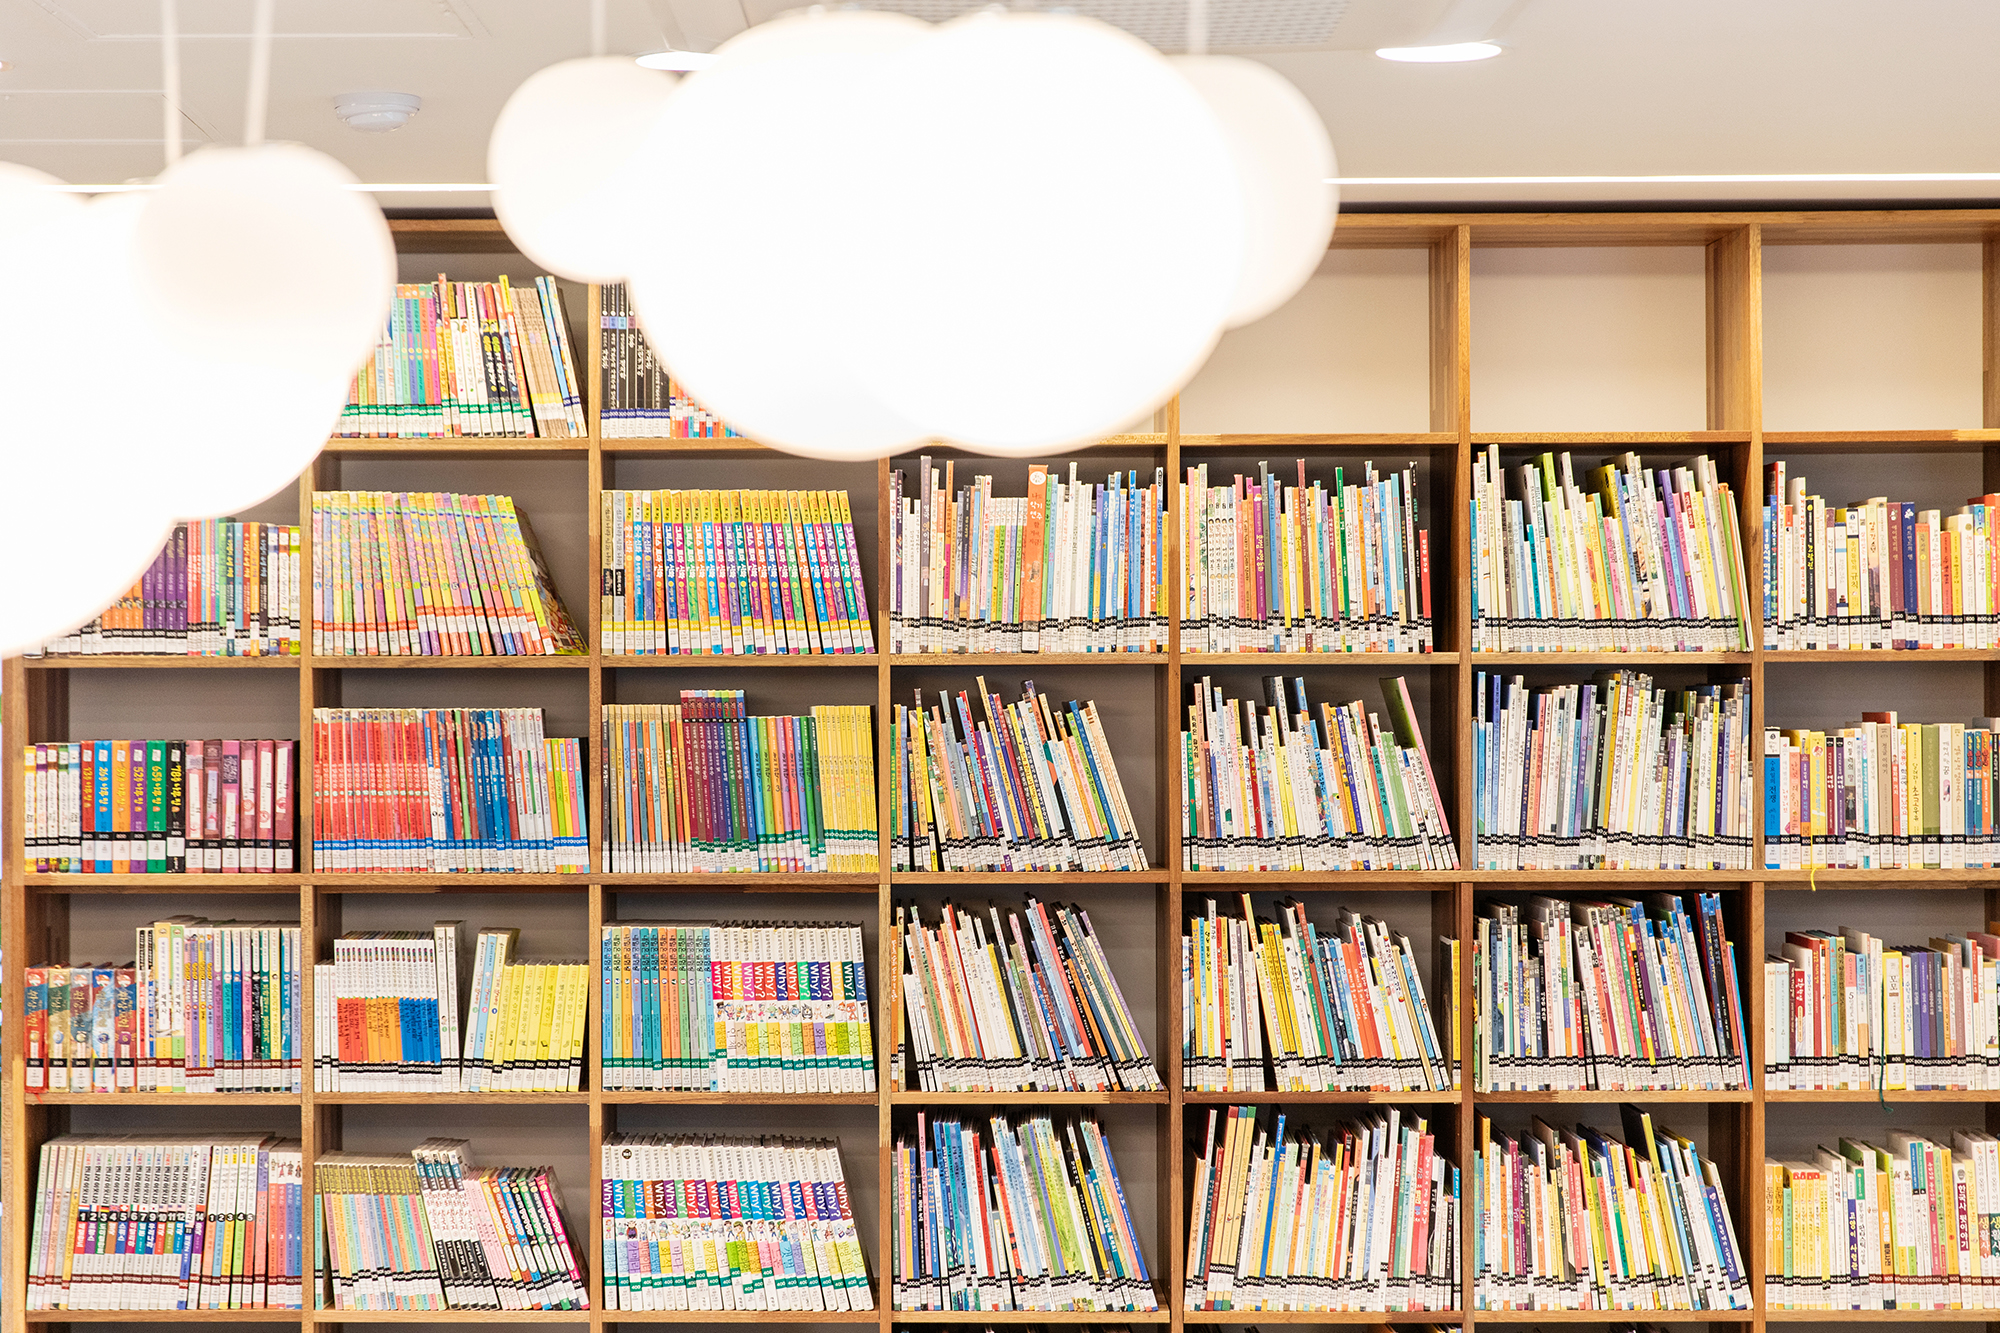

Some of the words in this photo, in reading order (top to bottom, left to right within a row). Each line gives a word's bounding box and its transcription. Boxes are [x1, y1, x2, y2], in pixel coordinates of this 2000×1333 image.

[1030, 501, 1043, 509] 악기
[723, 964, 733, 998] Why?
[733, 964, 744, 998] Why?
[743, 964, 755, 998] Why?
[754, 964, 766, 998] Why?
[765, 964, 777, 998] Why?
[777, 964, 788, 998] Why?
[788, 964, 799, 998] Why?
[799, 964, 811, 998] Why?
[810, 964, 822, 998] Why?
[820, 964, 833, 998] Why?
[832, 964, 844, 997] Why?
[843, 964, 856, 998] Why?
[856, 965, 867, 997] Why?
[602, 1181, 614, 1215] Why?
[614, 1182, 625, 1216] Why?
[635, 1183, 645, 1214] Why?
[645, 1184, 654, 1214] Why?
[654, 1182, 667, 1216] Why?
[665, 1182, 677, 1216] Why?
[676, 1182, 688, 1215] Why?
[686, 1182, 699, 1216] Why?
[696, 1181, 710, 1215] Why?
[710, 1183, 721, 1216] Why?
[719, 1184, 731, 1216] Why?
[728, 1183, 740, 1215] Why?
[739, 1183, 752, 1215] Why?
[749, 1183, 762, 1215] Why?
[762, 1184, 774, 1215] Why?
[771, 1183, 785, 1217] Why?
[781, 1185, 795, 1219] Why?
[791, 1183, 806, 1217] Why?
[803, 1183, 818, 1218] Why?
[815, 1184, 829, 1218] Why?
[825, 1183, 841, 1218] Why?
[837, 1183, 852, 1217] Why?
[80, 1213, 86, 1221] 1
[89, 1213, 97, 1221] 2
[100, 1213, 108, 1222] 3
[109, 1213, 117, 1221] 4
[120, 1213, 127, 1221] 5
[131, 1213, 138, 1221] 6
[140, 1213, 147, 1221] 7
[150, 1213, 157, 1221] 9
[158, 1213, 167, 1221] 10
[167, 1213, 176, 1221] 11
[176, 1213, 186, 1221] 12
[195, 1212, 204, 1221] 14
